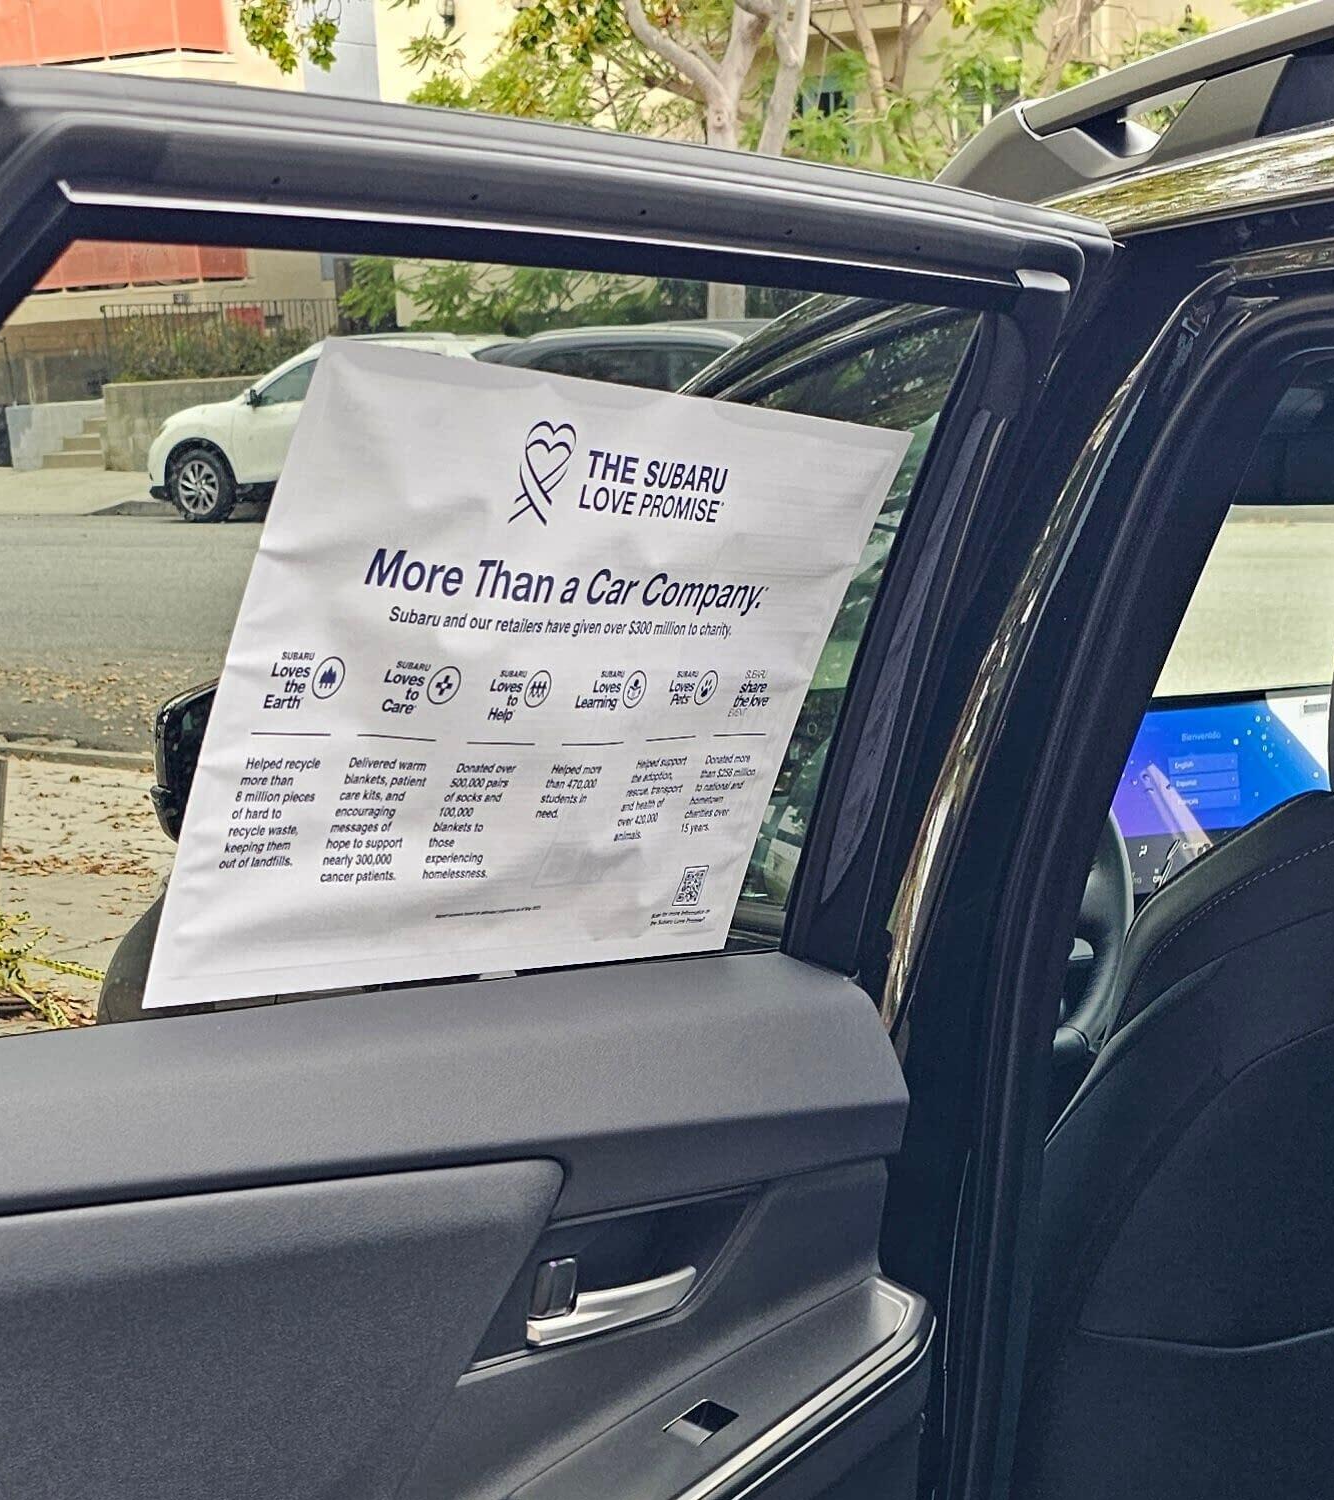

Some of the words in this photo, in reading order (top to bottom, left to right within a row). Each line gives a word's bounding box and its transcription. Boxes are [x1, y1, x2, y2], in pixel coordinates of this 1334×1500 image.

[586, 450, 639, 485] THE
[644, 460, 728, 494] SUBARU
[578, 484, 637, 515] LOVE
[638, 493, 721, 523] PROMISE
[365, 548, 464, 597] More
[474, 560, 556, 604] Than
[560, 576, 581, 605] a
[587, 568, 638, 607] Car
[389, 606, 441, 627] Subaru
[443, 612, 468, 629] and
[469, 616, 492, 630] our
[495, 614, 543, 635] retailers
[545, 617, 570, 635] have
[572, 619, 602, 638] given
[603, 623, 627, 636] over
[628, 620, 652, 637] $300
[652, 620, 686, 637] million
[687, 622, 698, 637] to
[699, 621, 733, 640] charity.
[281, 651, 315, 661] SUBARU
[271, 662, 311, 679] Loves
[396, 660, 432, 672] SUBARU
[383, 669, 426, 687] Loves
[499, 670, 528, 679] SUBARU
[601, 670, 626, 679] SUBARU
[676, 670, 699, 679] SUBARU
[284, 678, 307, 694] the
[489, 679, 523, 694] Loves
[593, 680, 622, 694] Loves
[669, 680, 696, 694] Loves
[738, 680, 768, 694] share
[405, 687, 420, 702] to
[506, 694, 518, 707] to
[670, 693, 690, 706] Pets
[263, 694, 302, 710] Earth
[381, 698, 415, 714] Care
[574, 695, 619, 710] Learning
[487, 708, 514, 724] Help
[245, 757, 283, 774] Helped
[284, 757, 322, 773] recycle
[348, 757, 397, 770] Delivered
[398, 761, 427, 772] warm
[456, 763, 495, 774] Donated
[495, 765, 517, 774] over
[550, 764, 582, 776] Helped
[582, 765, 603, 775] more
[240, 776, 269, 786] more
[270, 775, 294, 786] than
[344, 774, 388, 787] blankets,
[389, 775, 427, 788] patient
[449, 778, 485, 790] 500,000
[485, 778, 510, 790] pairs
[545, 778, 565, 789] than
[235, 791, 243, 803] 8
[244, 791, 281, 802] million
[282, 791, 316, 805] pieces
[339, 791, 362, 802] care
[362, 789, 383, 802] kits,
[384, 790, 406, 802] and
[443, 792, 454, 803] of
[455, 792, 483, 803] socks
[483, 792, 503, 803] and
[540, 793, 578, 804] students
[578, 794, 588, 804] in
[231, 807, 243, 819] of
[244, 808, 269, 819] hard
[271, 808, 283, 819] to
[334, 806, 396, 820] encouraging
[438, 807, 475, 819] 100,000
[227, 824, 266, 840] recycle
[268, 825, 299, 837] waste,
[329, 823, 379, 837] messages
[380, 821, 393, 833] of
[432, 822, 473, 833] blankets
[473, 822, 484, 833] to
[224, 842, 265, 856] keeping
[266, 840, 292, 851] them
[325, 838, 351, 851] hope
[352, 838, 364, 849] to
[365, 837, 403, 852] support
[428, 837, 455, 848] those
[219, 858, 237, 869] out
[238, 856, 249, 868] of
[250, 855, 293, 868] landfills.
[322, 854, 354, 869] nearly
[355, 853, 393, 867] 300,000
[425, 852, 484, 865] experiencing
[320, 872, 354, 882] cancer
[355, 870, 396, 884] patients.
